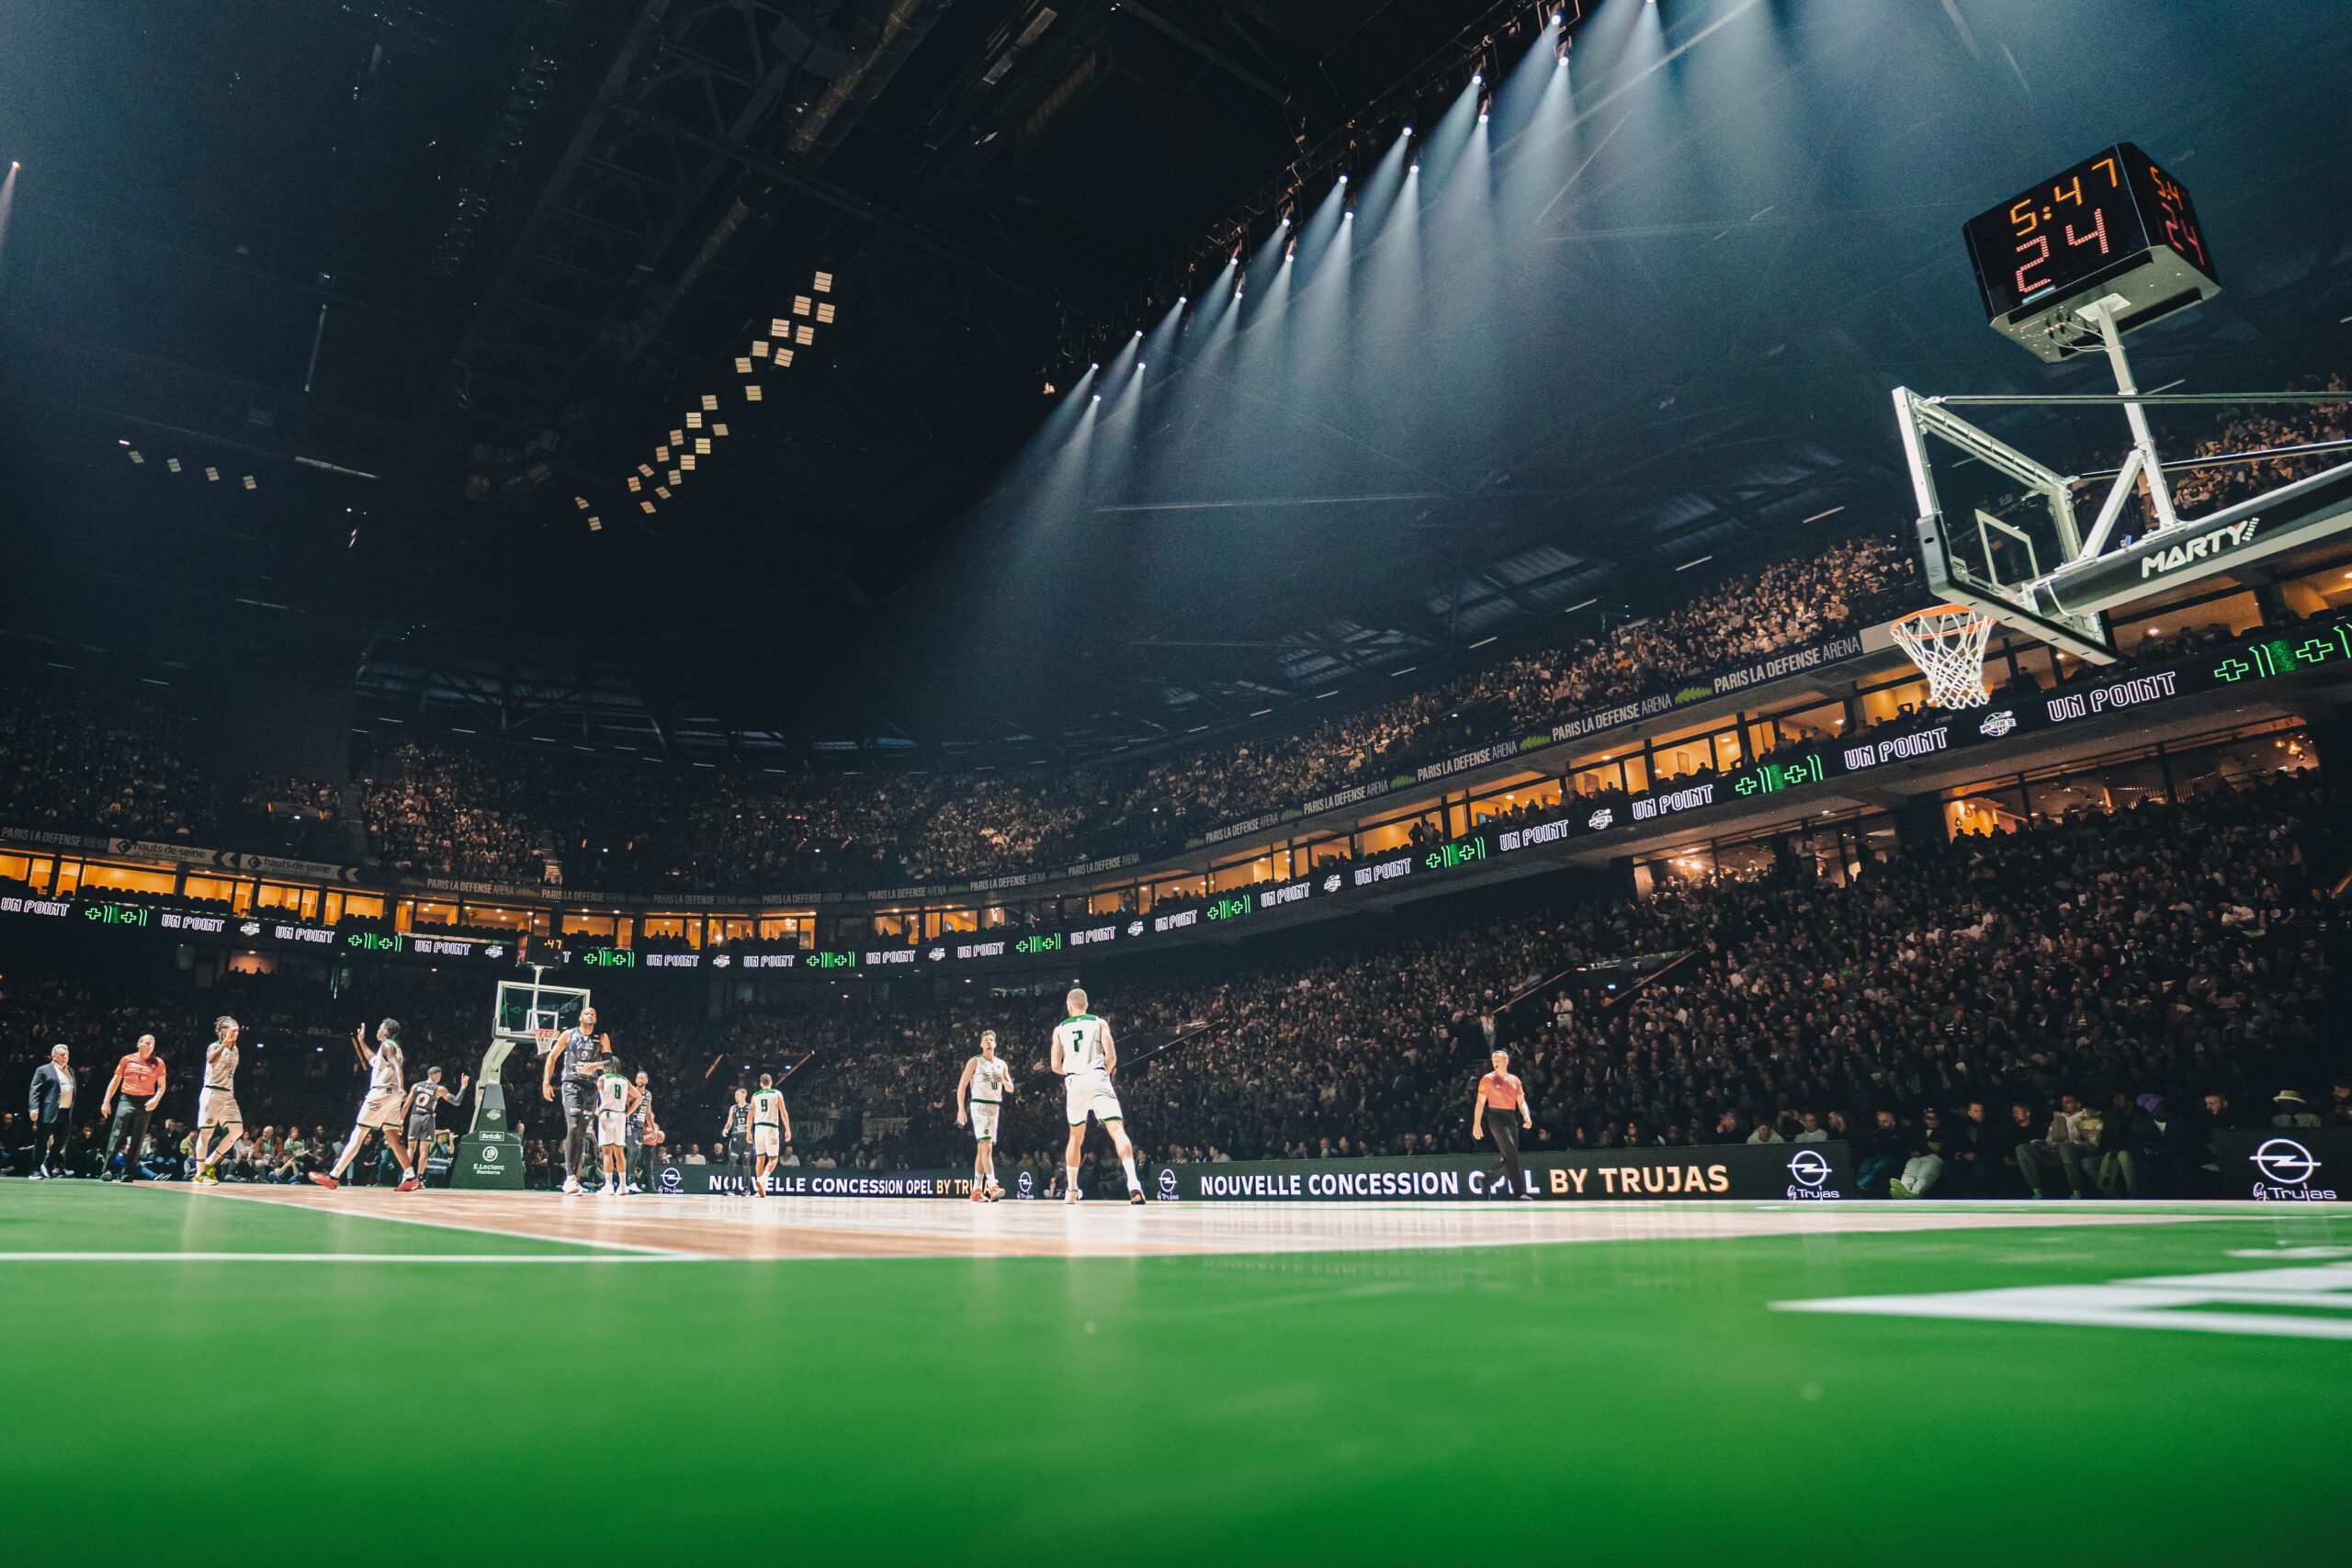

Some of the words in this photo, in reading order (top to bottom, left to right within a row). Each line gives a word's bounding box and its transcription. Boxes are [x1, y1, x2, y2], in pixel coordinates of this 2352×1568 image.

[2010, 158, 2118, 236] 5:47
[2015, 209, 2109, 294] 24
[2142, 520, 2248, 578] MARTY
[1714, 670, 1748, 693] PARIS
[1750, 665, 1766, 682] LA
[1767, 648, 1821, 678] DEFENSE
[1823, 636, 1860, 661] ARENA
[2047, 694, 2086, 721] UN
[2090, 671, 2176, 712] POINT
[1553, 721, 1581, 741] PARIS
[1582, 717, 1595, 733] LA
[1596, 703, 1639, 729] DEFENSE
[1642, 694, 1672, 716] ARENA
[1844, 745, 1875, 770] UN
[1878, 728, 1947, 762] POINT
[1418, 762, 1442, 781] PARIS
[1442, 761, 1453, 774] LA
[1453, 748, 1490, 771] DEFENSE
[1492, 740, 1518, 760] ARENA
[1304, 800, 1324, 815] PARIS
[1325, 797, 1334, 808] LA
[1335, 786, 1366, 807] DEFENSE
[1367, 779, 1388, 797] ARENA
[1633, 798, 1657, 819] UN
[1659, 784, 1713, 814] POINT
[2, 827, 28, 840] PARIS
[29, 830, 40, 841] LA
[1205, 829, 1224, 843] PARIS
[1224, 827, 1232, 838] LA
[1261, 812, 1279, 827] ARENA
[1499, 831, 1521, 851] UN
[1522, 819, 1568, 846] POINT
[1068, 864, 1085, 877] PARIS
[1086, 863, 1093, 873] LA
[1355, 867, 1372, 886] UN
[1374, 858, 1411, 881] POINT
[426, 878, 448, 889] PARIS
[450, 882, 458, 890] LA
[970, 880, 989, 891] PARIS
[989, 879, 998, 888] LA
[542, 889, 562, 899] PARIS
[564, 891, 573, 900] LA
[867, 890, 888, 900] PARIS
[888, 889, 897, 898] LA
[1261, 891, 1275, 908] UN
[1277, 882, 1310, 904] POINT
[1, 897, 22, 911] UN
[24, 900, 70, 916] POINT
[162, 914, 181, 928] UN
[183, 917, 225, 931] POINT
[1155, 917, 1168, 931] UN
[1170, 909, 1197, 929] POINT
[276, 926, 293, 939] UN
[295, 929, 334, 943] POINT
[1070, 931, 1084, 945] UN
[1086, 926, 1115, 943] POINT
[415, 940, 432, 953] UN
[434, 942, 471, 955] POINT
[866, 952, 881, 964] UN
[883, 950, 916, 964] POINT
[957, 945, 971, 958] UN
[973, 942, 1004, 957] POINT
[647, 954, 662, 966] UN
[664, 954, 699, 966] POINT
[744, 955, 759, 967] UN
[761, 955, 795, 967] POINT
[1072, 1031, 1083, 1052] 7
[416, 1093, 430, 1107] 0
[761, 1099, 768, 1112] 9
[811, 1178, 903, 1194] CONCESSION
[906, 1179, 933, 1194] OPEL
[936, 1179, 951, 1194] BY
[1201, 1176, 1301, 1195] NOUVELLE
[1308, 1171, 1458, 1195] CONCESSION
[1550, 1168, 1588, 1193] BY
[1599, 1165, 1729, 1193] TRUJAS
[663, 1186, 684, 1194] Trujas
[1796, 1188, 1839, 1201] Trujas
[2253, 1182, 2268, 1201] by
[2267, 1182, 2337, 1201] Trujas
